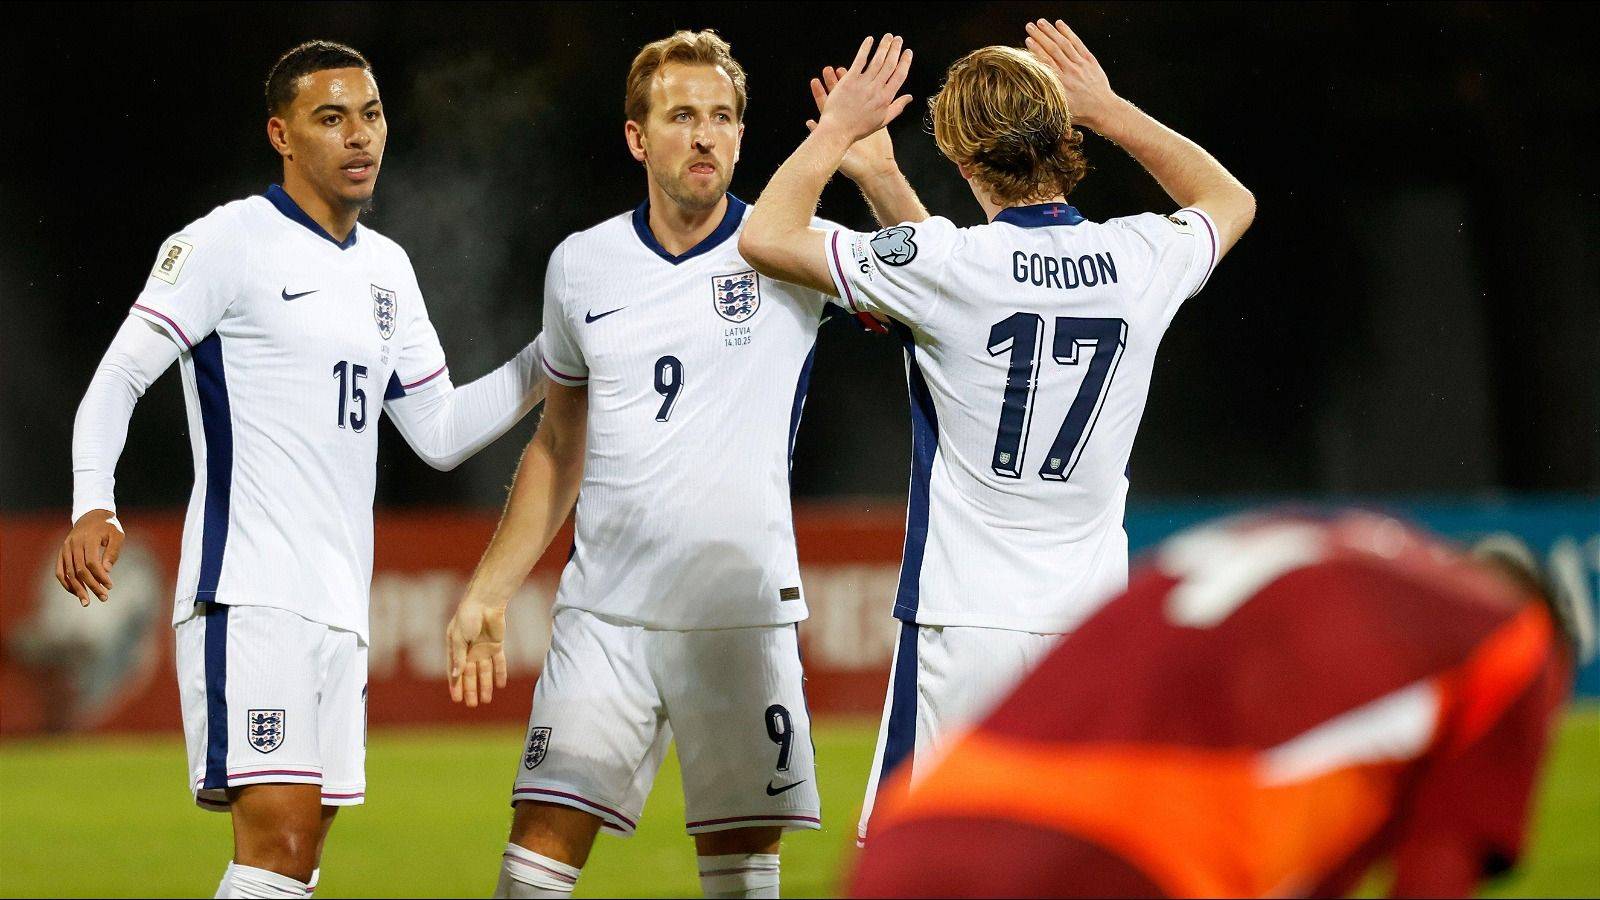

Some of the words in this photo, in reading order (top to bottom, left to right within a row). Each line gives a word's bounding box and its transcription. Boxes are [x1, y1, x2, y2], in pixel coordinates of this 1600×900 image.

[1013, 251, 1118, 289] GORDON
[724, 326, 752, 337] LATVIA
[724, 335, 752, 347] 14.10.25
[333, 360, 368, 433] 15
[654, 355, 684, 422] 9
[987, 312, 1128, 482] 17
[765, 704, 794, 771] 9
